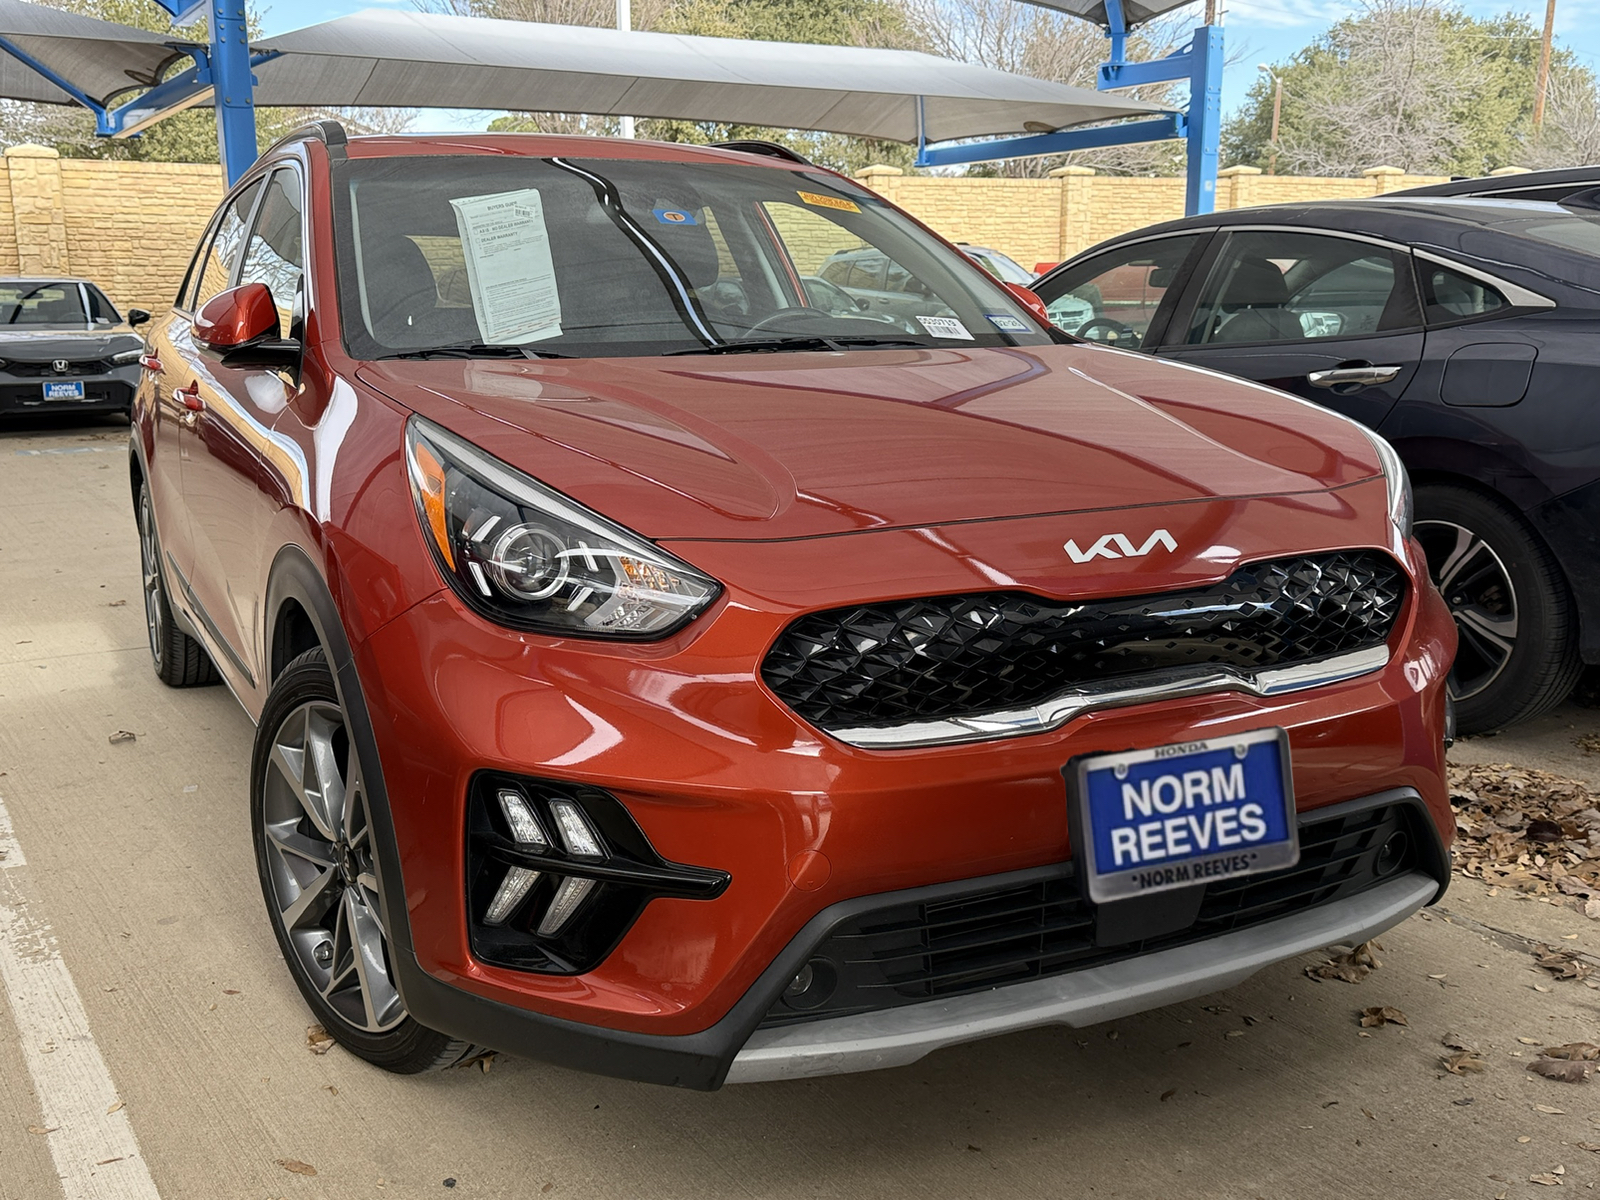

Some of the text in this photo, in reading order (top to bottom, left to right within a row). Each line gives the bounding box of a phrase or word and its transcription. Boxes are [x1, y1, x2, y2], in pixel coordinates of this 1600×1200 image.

[487, 203, 505, 211] BUYERS
[497, 231, 518, 240] WARRANTY
[48, 390, 79, 398] REEVES
[1063, 529, 1179, 564] KIA
[1154, 741, 1209, 758] HONDA
[1121, 763, 1246, 820] NORM
[1111, 803, 1267, 866] REEVES
